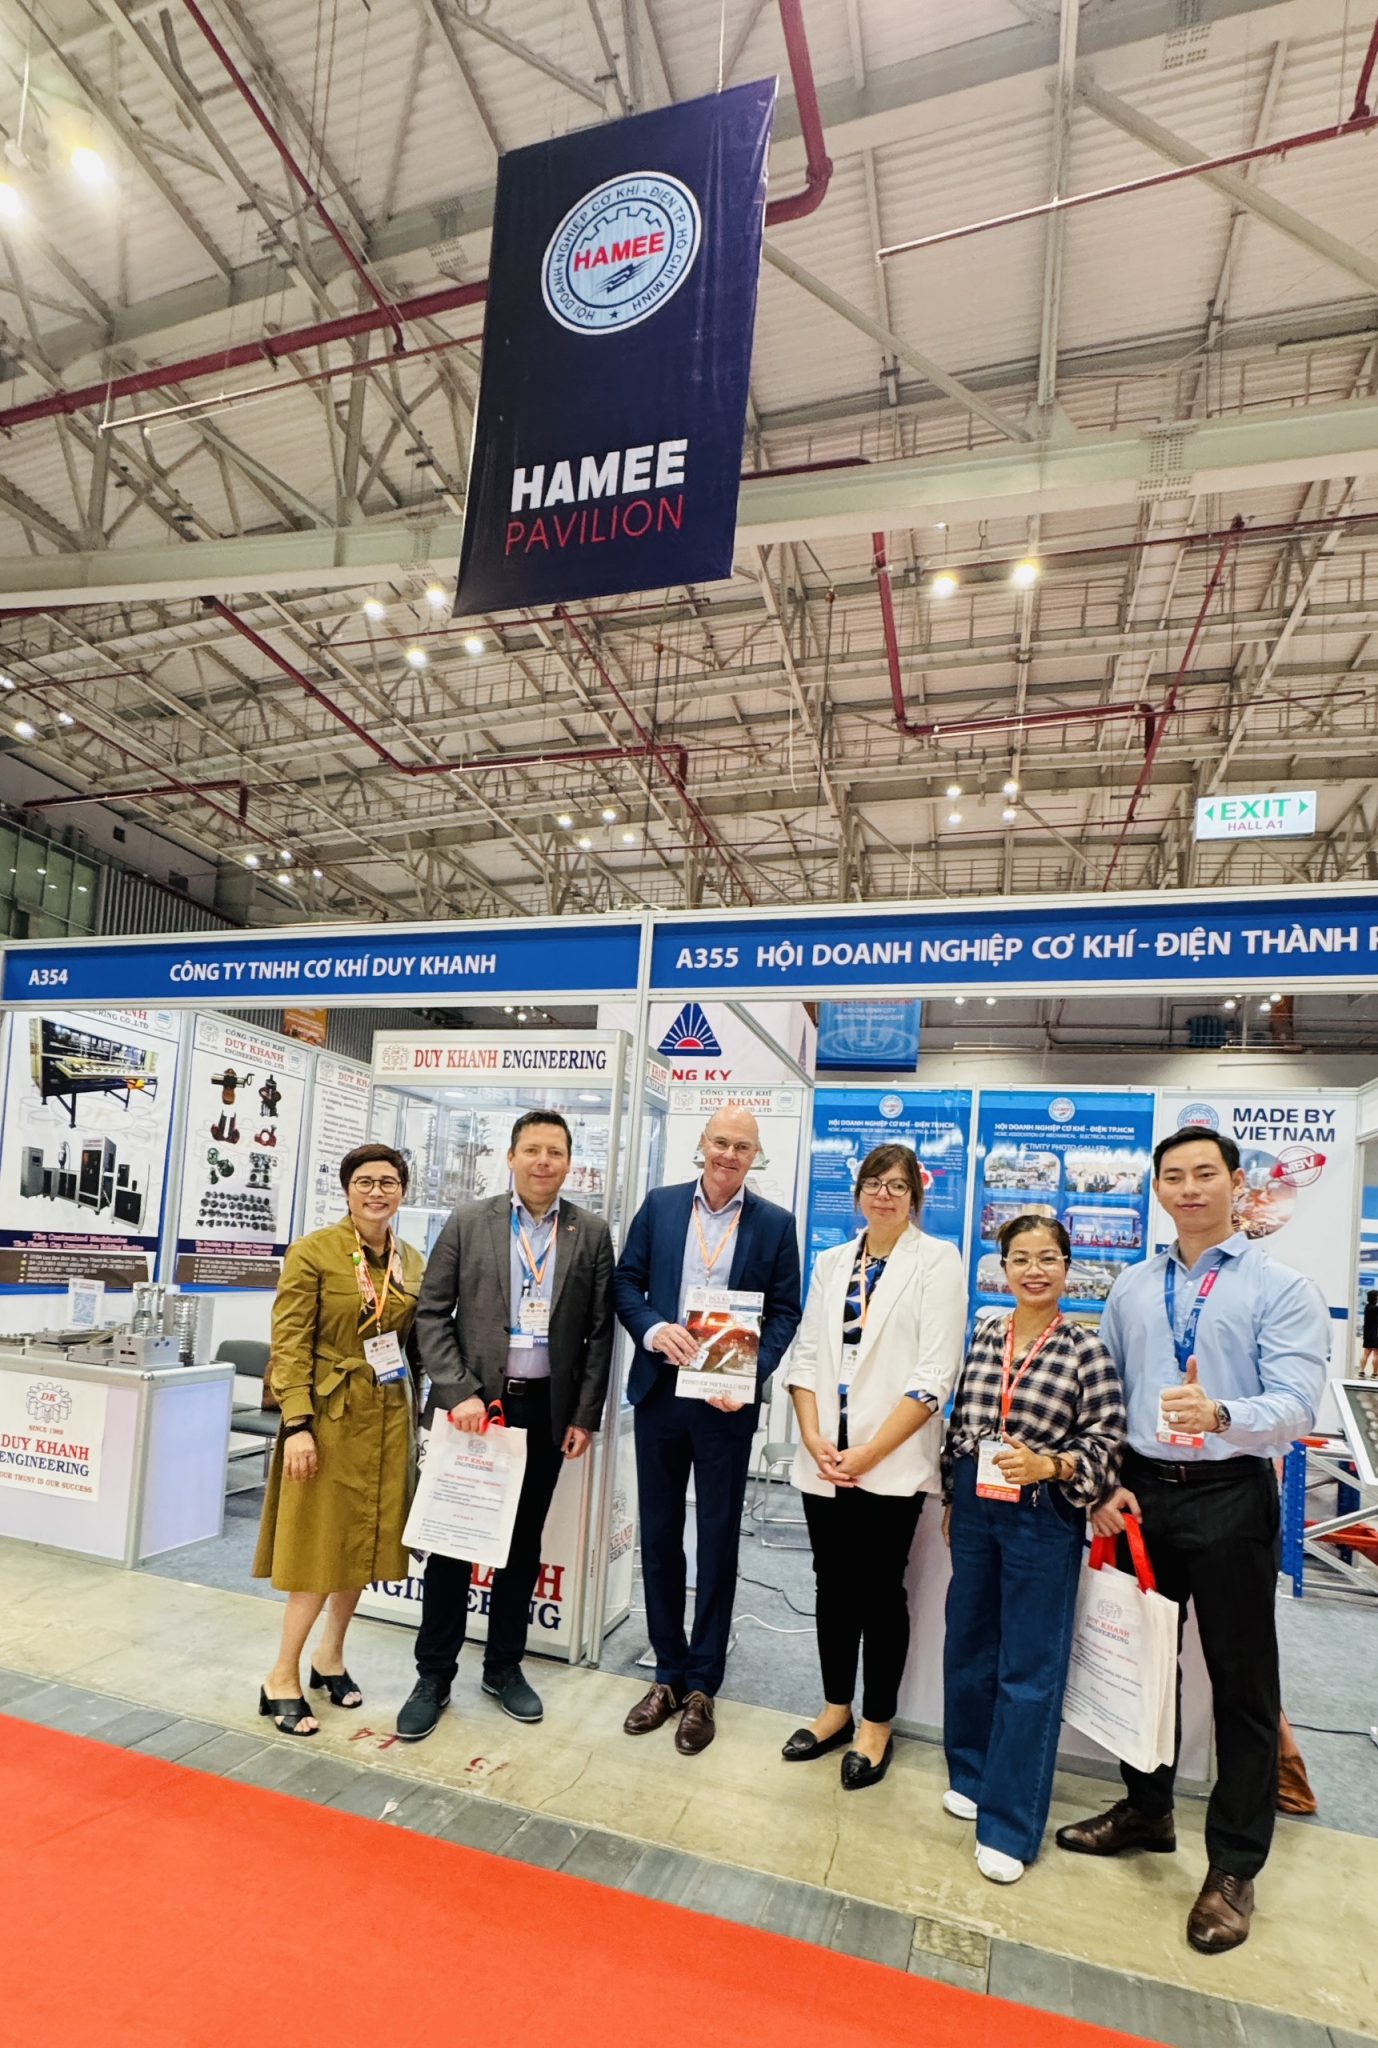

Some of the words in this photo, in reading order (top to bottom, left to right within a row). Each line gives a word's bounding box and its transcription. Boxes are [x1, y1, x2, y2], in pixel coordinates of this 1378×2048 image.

[573, 231, 665, 272] HAMEE
[553, 266, 575, 311] DOANH
[631, 280, 665, 311] MINH
[510, 438, 688, 513] HAMEE
[505, 494, 683, 557] PAVILION
[1220, 798, 1291, 820] EXIT
[1228, 821, 1262, 831] HALL
[676, 947, 739, 969] A355
[756, 940, 803, 972] HỘI
[812, 941, 912, 966] DOANH
[920, 933, 1023, 967] NGHIỆP
[1031, 934, 1076, 960] CƠ
[1241, 923, 1358, 955] THÀNH
[28, 969, 68, 985] A354
[169, 960, 219, 982] CÔNG
[223, 962, 246, 980] TY
[248, 960, 300, 979] TNHH
[303, 958, 332, 978] CƠ
[334, 954, 371, 978] KHÍ
[372, 956, 417, 977] DUY
[420, 954, 497, 975] KHANH
[225, 1037, 247, 1050] DUY
[249, 1044, 284, 1063] KHANH
[414, 1049, 443, 1068] DUY
[446, 1049, 499, 1068] KHANH
[502, 1050, 608, 1069] ENGINEERING
[356, 1077, 370, 1088] KH
[671, 1069, 698, 1081] NG
[704, 1069, 732, 1081] KY
[699, 1088, 724, 1096] CÔNG
[700, 1097, 724, 1106] DUY
[727, 1098, 770, 1106] KHANH
[840, 1119, 864, 1127] DOANH
[1233, 1107, 1298, 1123] MADE
[1304, 1109, 1336, 1124] BY
[1232, 1126, 1336, 1143] VIETNAM
[1281, 1155, 1315, 1175] MBV
[40, 1392, 57, 1402] DK
[29, 1425, 47, 1433] SINCE
[1, 1433, 32, 1451] DUY
[35, 1439, 90, 1461] KHANH
[0, 1450, 89, 1477] ENGINEERING
[15, 1473, 35, 1484] TRUST
[37, 1477, 44, 1485] IS
[45, 1479, 60, 1487] OUR
[61, 1480, 93, 1494] SUCCESS
